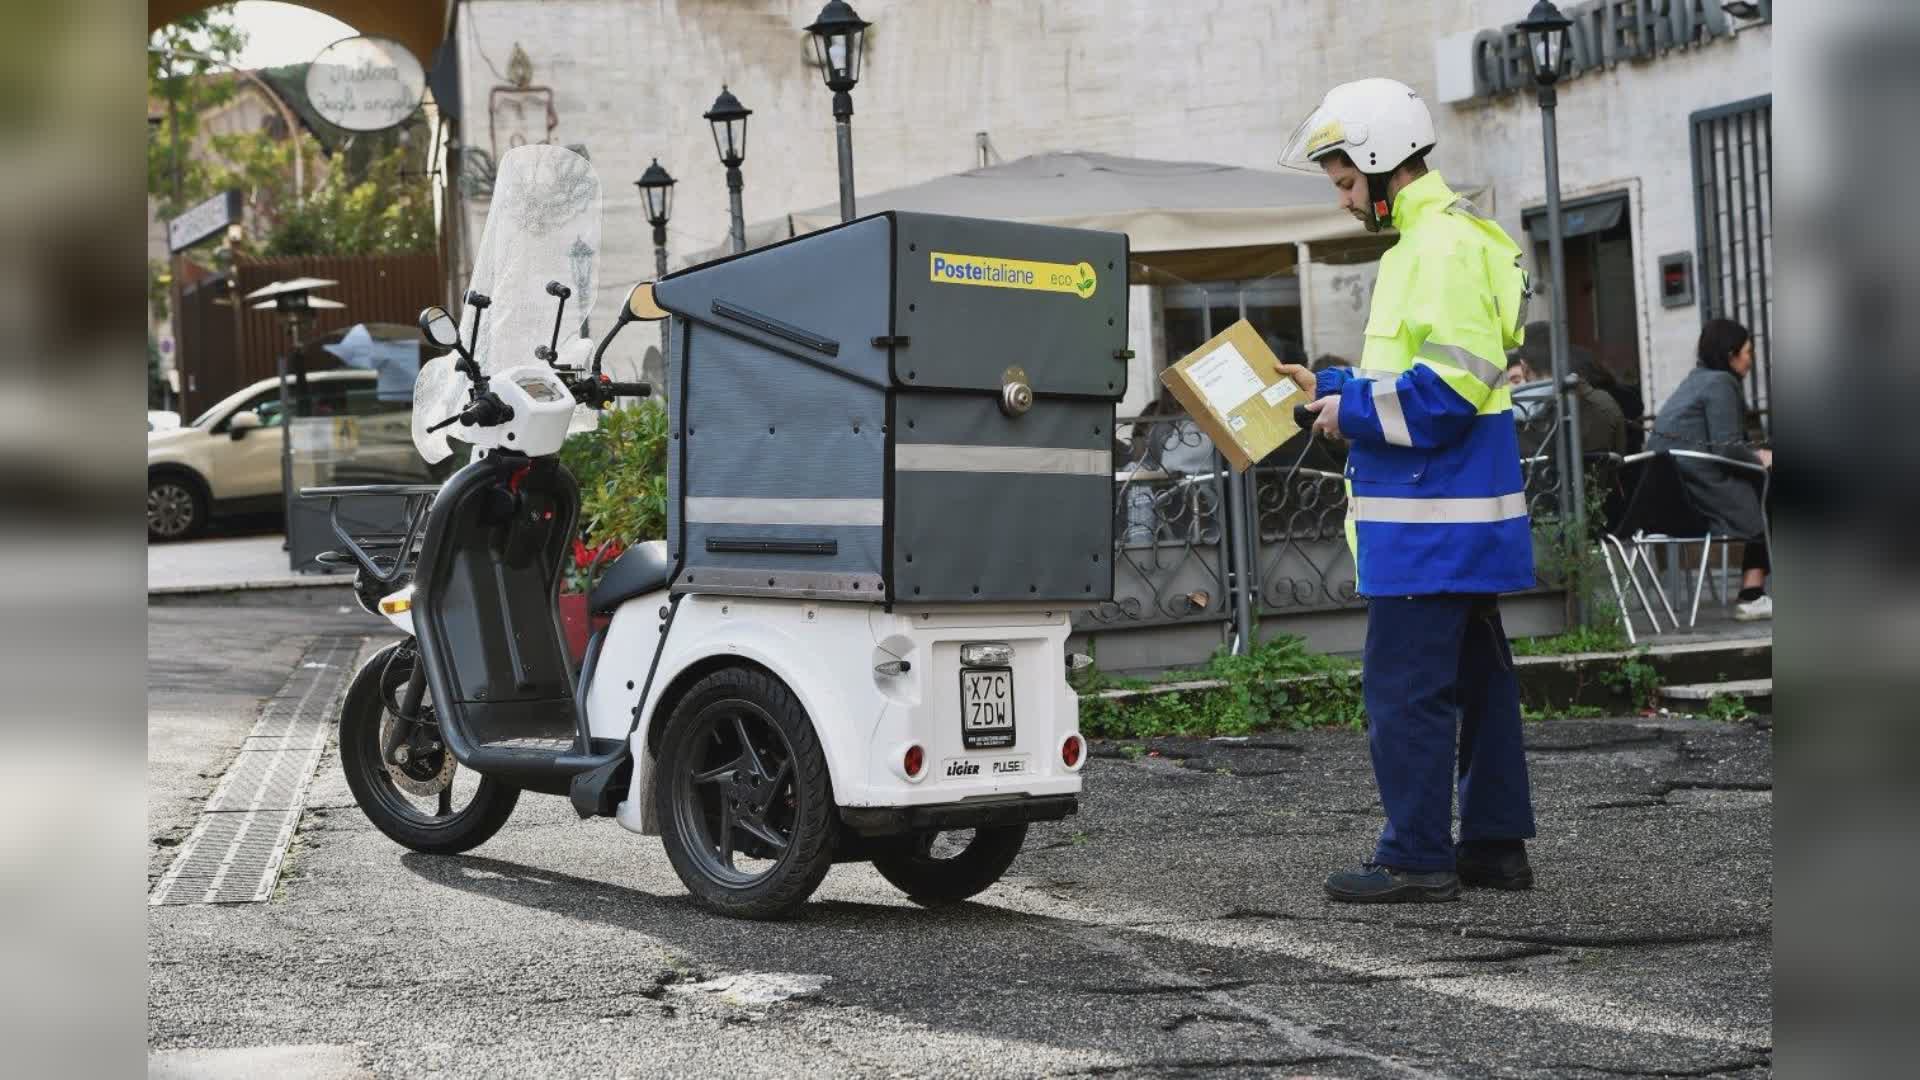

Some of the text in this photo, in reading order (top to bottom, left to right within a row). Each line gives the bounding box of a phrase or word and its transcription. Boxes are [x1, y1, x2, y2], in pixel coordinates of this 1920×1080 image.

[1472, 0, 1729, 97] GEATERIA
[1050, 273, 1073, 287] eco
[970, 676, 1006, 700] X7C
[971, 702, 1006, 726] ZDW
